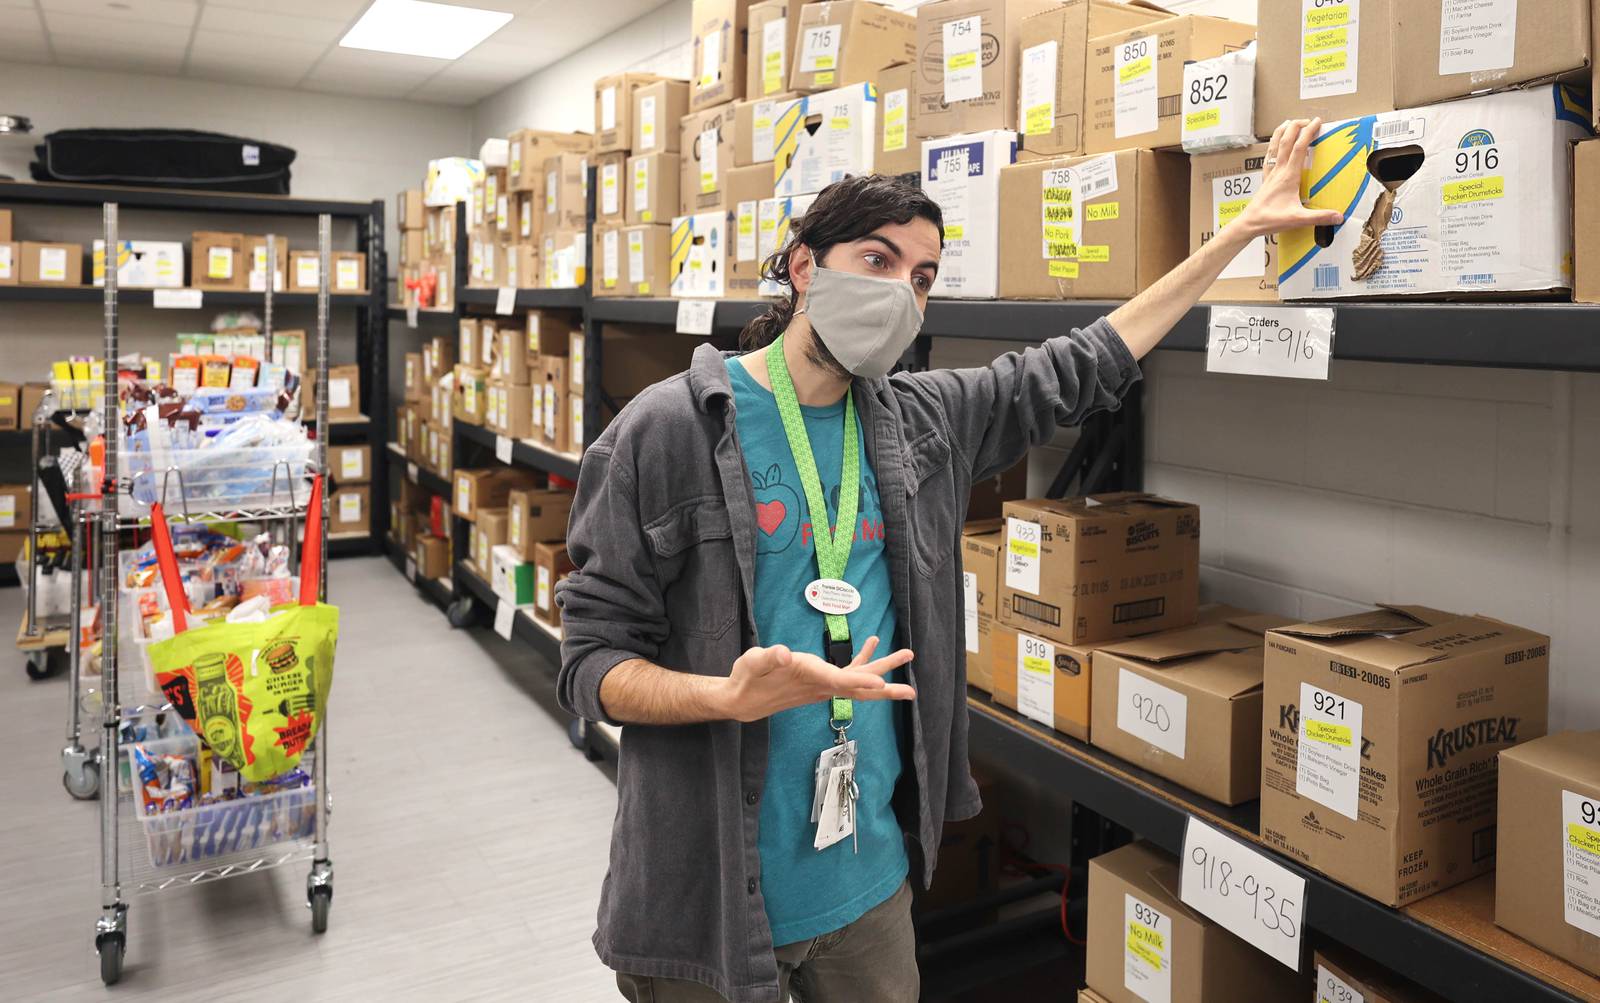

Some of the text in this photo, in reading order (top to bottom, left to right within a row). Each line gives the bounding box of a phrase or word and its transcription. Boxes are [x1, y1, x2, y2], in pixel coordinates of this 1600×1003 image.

[1307, 12, 1348, 24] Vegetarian
[952, 21, 971, 37] 754
[812, 30, 832, 48] 715
[1124, 40, 1147, 62] 850
[1190, 74, 1228, 105] 852
[943, 157, 962, 174] 755
[1456, 148, 1499, 174] 916
[1052, 170, 1070, 184] 758
[1224, 176, 1252, 197] 852
[1443, 186, 1502, 202] Chicken Drumsticks
[1088, 206, 1118, 218] No Milk
[1220, 204, 1240, 215] Special
[1055, 228, 1070, 240] Pork
[1248, 316, 1280, 328] Orders
[1214, 327, 1314, 364] 754-916
[1026, 639, 1046, 659] 919
[1132, 692, 1170, 732] 920
[1314, 692, 1345, 720] 921
[1270, 728, 1294, 746] Whole
[1306, 730, 1324, 739] Chicken
[1427, 716, 1520, 771] KRUSTEAZ
[1320, 776, 1330, 785] Bag
[1416, 774, 1443, 792] Whole
[1444, 766, 1467, 782] Grain
[1569, 834, 1596, 851] Chicken
[1404, 849, 1424, 864] KEEP
[1576, 860, 1589, 870] Rice
[1398, 860, 1429, 879] FROZEN
[1576, 875, 1589, 886] Rice
[1192, 846, 1296, 938] 918-935
[1578, 898, 1590, 911] Bag
[1136, 904, 1160, 928] 937
[1130, 923, 1162, 949] No Milk
[1327, 978, 1352, 1003] 939
